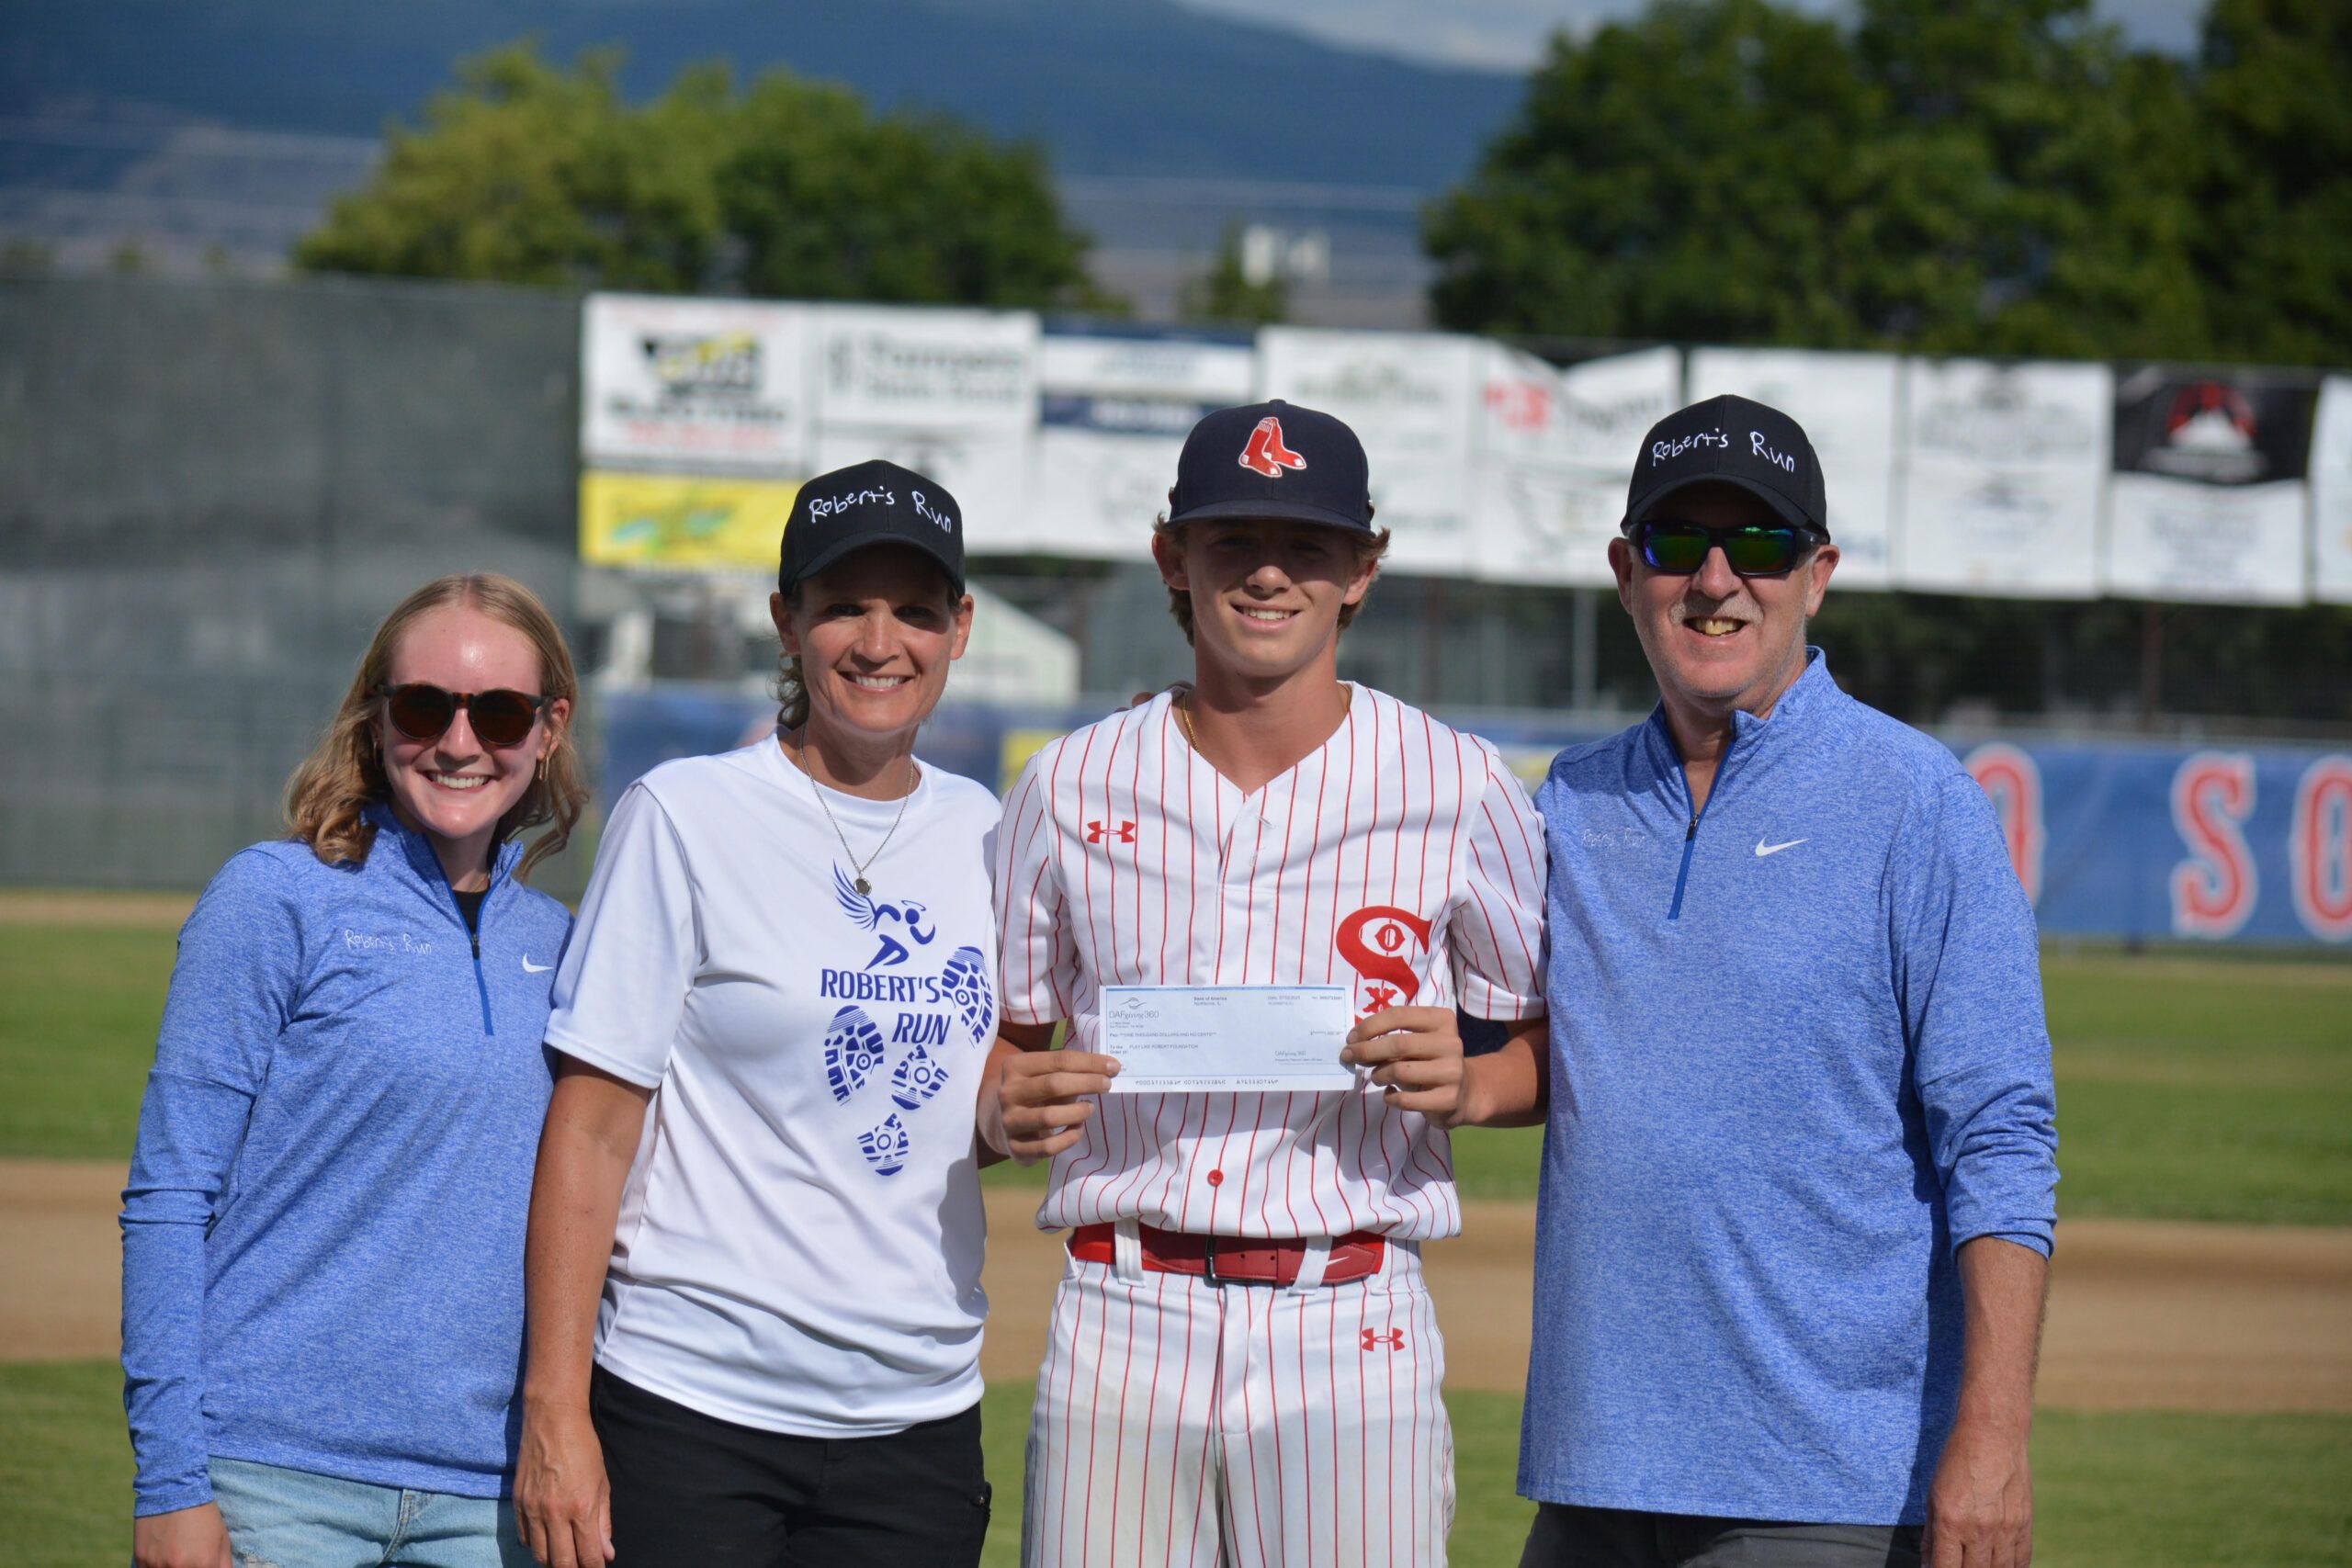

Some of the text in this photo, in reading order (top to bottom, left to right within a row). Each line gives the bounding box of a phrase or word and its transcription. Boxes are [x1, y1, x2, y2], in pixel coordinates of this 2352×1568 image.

[1652, 427, 1795, 473] Robert's Run
[808, 485, 952, 535] Robert's Run
[345, 929, 432, 955] Robert's Run
[820, 968, 941, 1004] ROBERT'S
[891, 1011, 952, 1045] RUN
